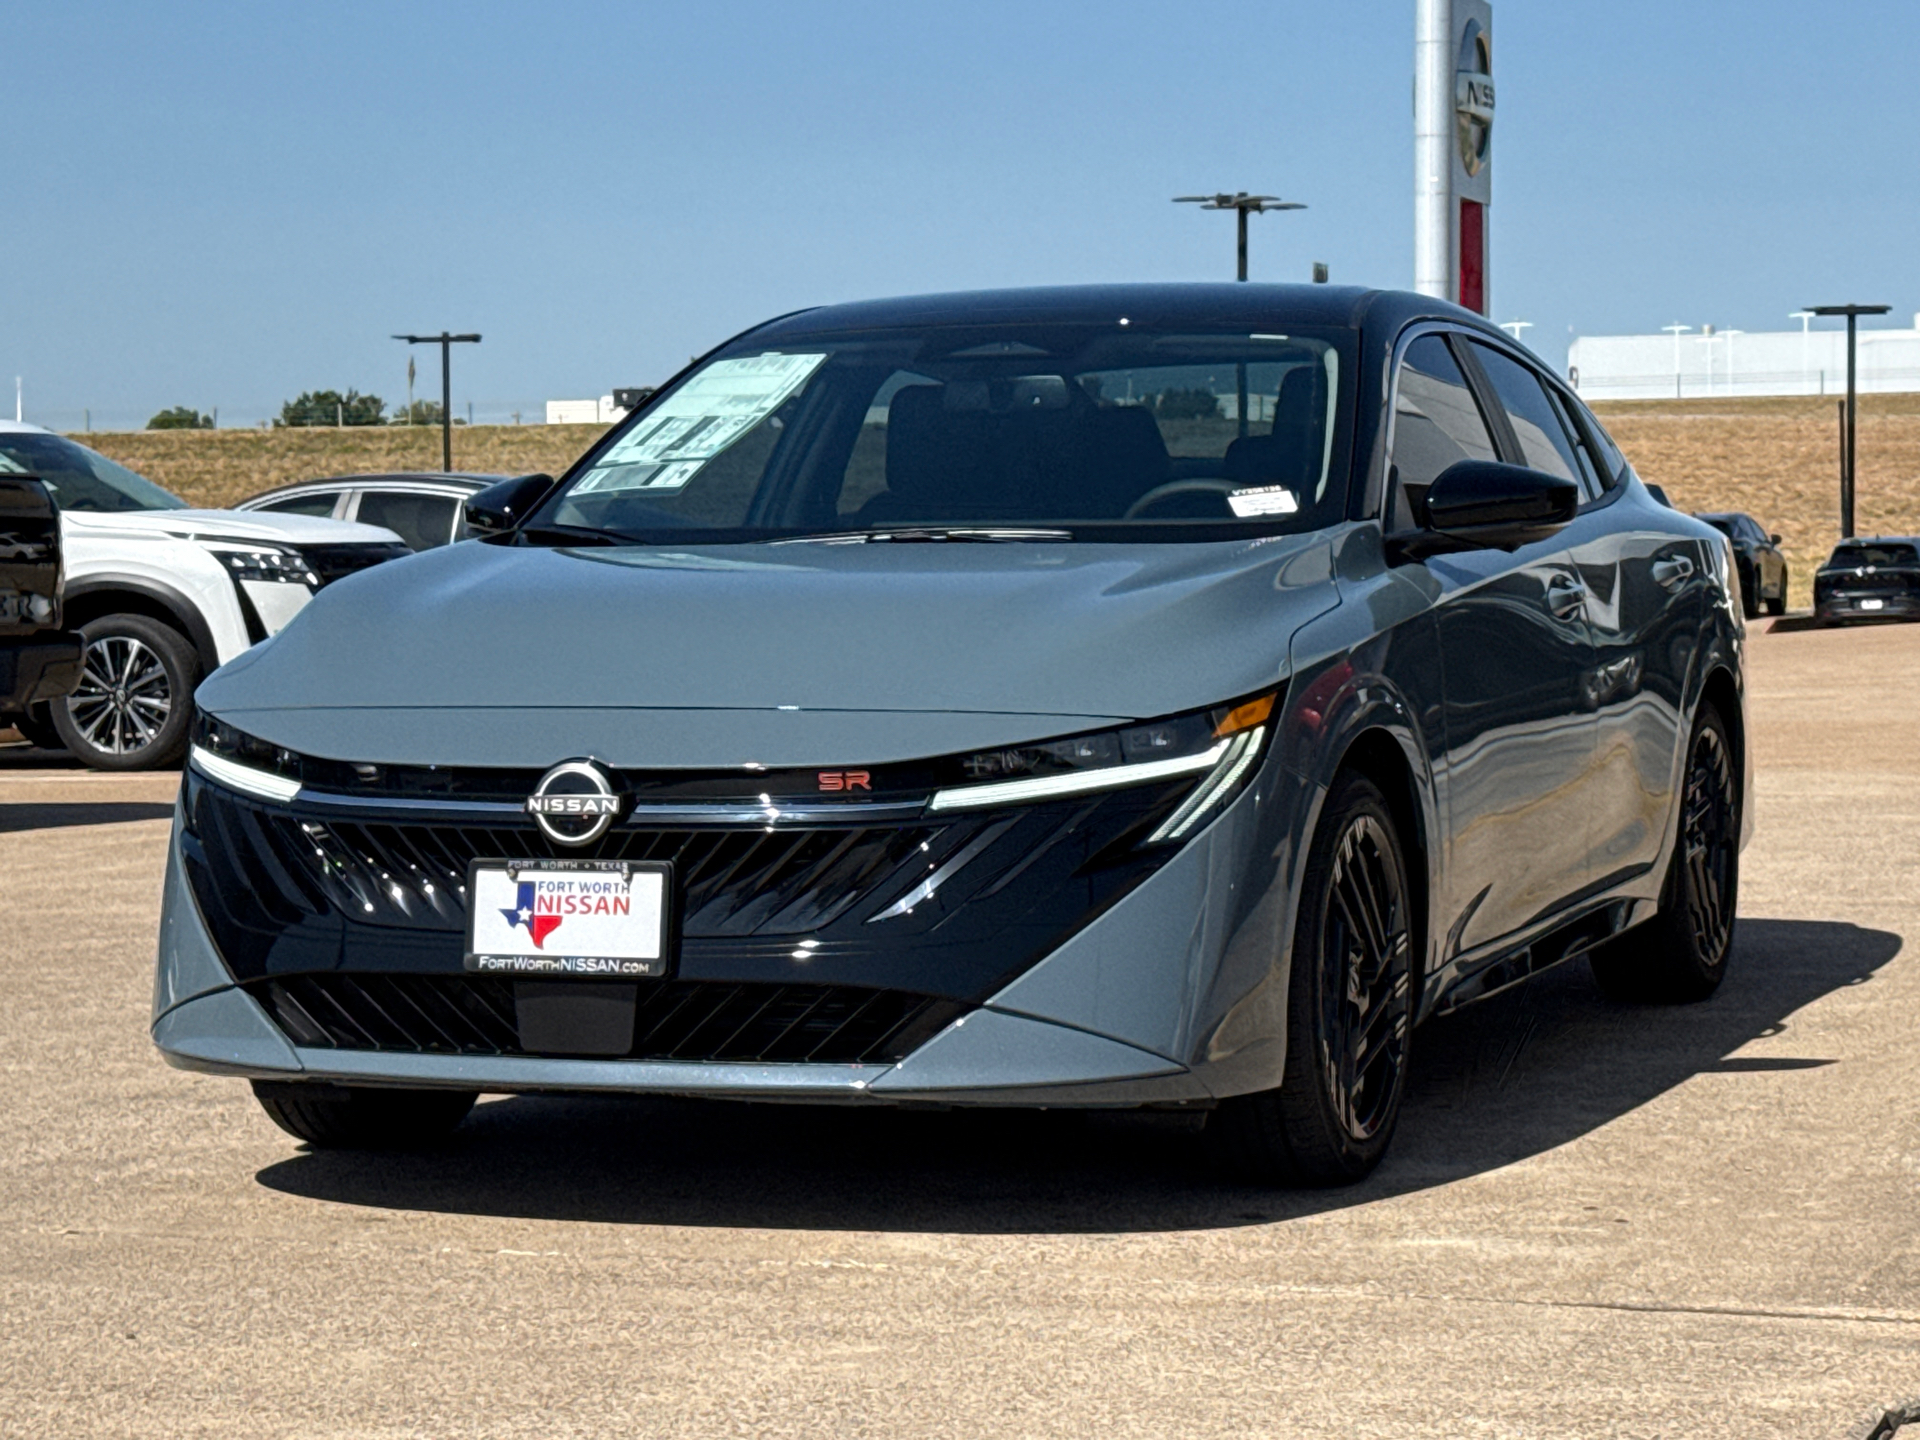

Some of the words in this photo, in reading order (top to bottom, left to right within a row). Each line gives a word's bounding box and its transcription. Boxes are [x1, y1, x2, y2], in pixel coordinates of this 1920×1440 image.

[818, 770, 872, 791] SR
[528, 797, 618, 813] NISSAN
[508, 860, 535, 870] FORT
[540, 860, 578, 870] WORTH
[594, 861, 629, 870] TEXAS
[538, 881, 575, 893] FORT
[578, 881, 631, 895] WORTH
[537, 894, 631, 916] NISSAN
